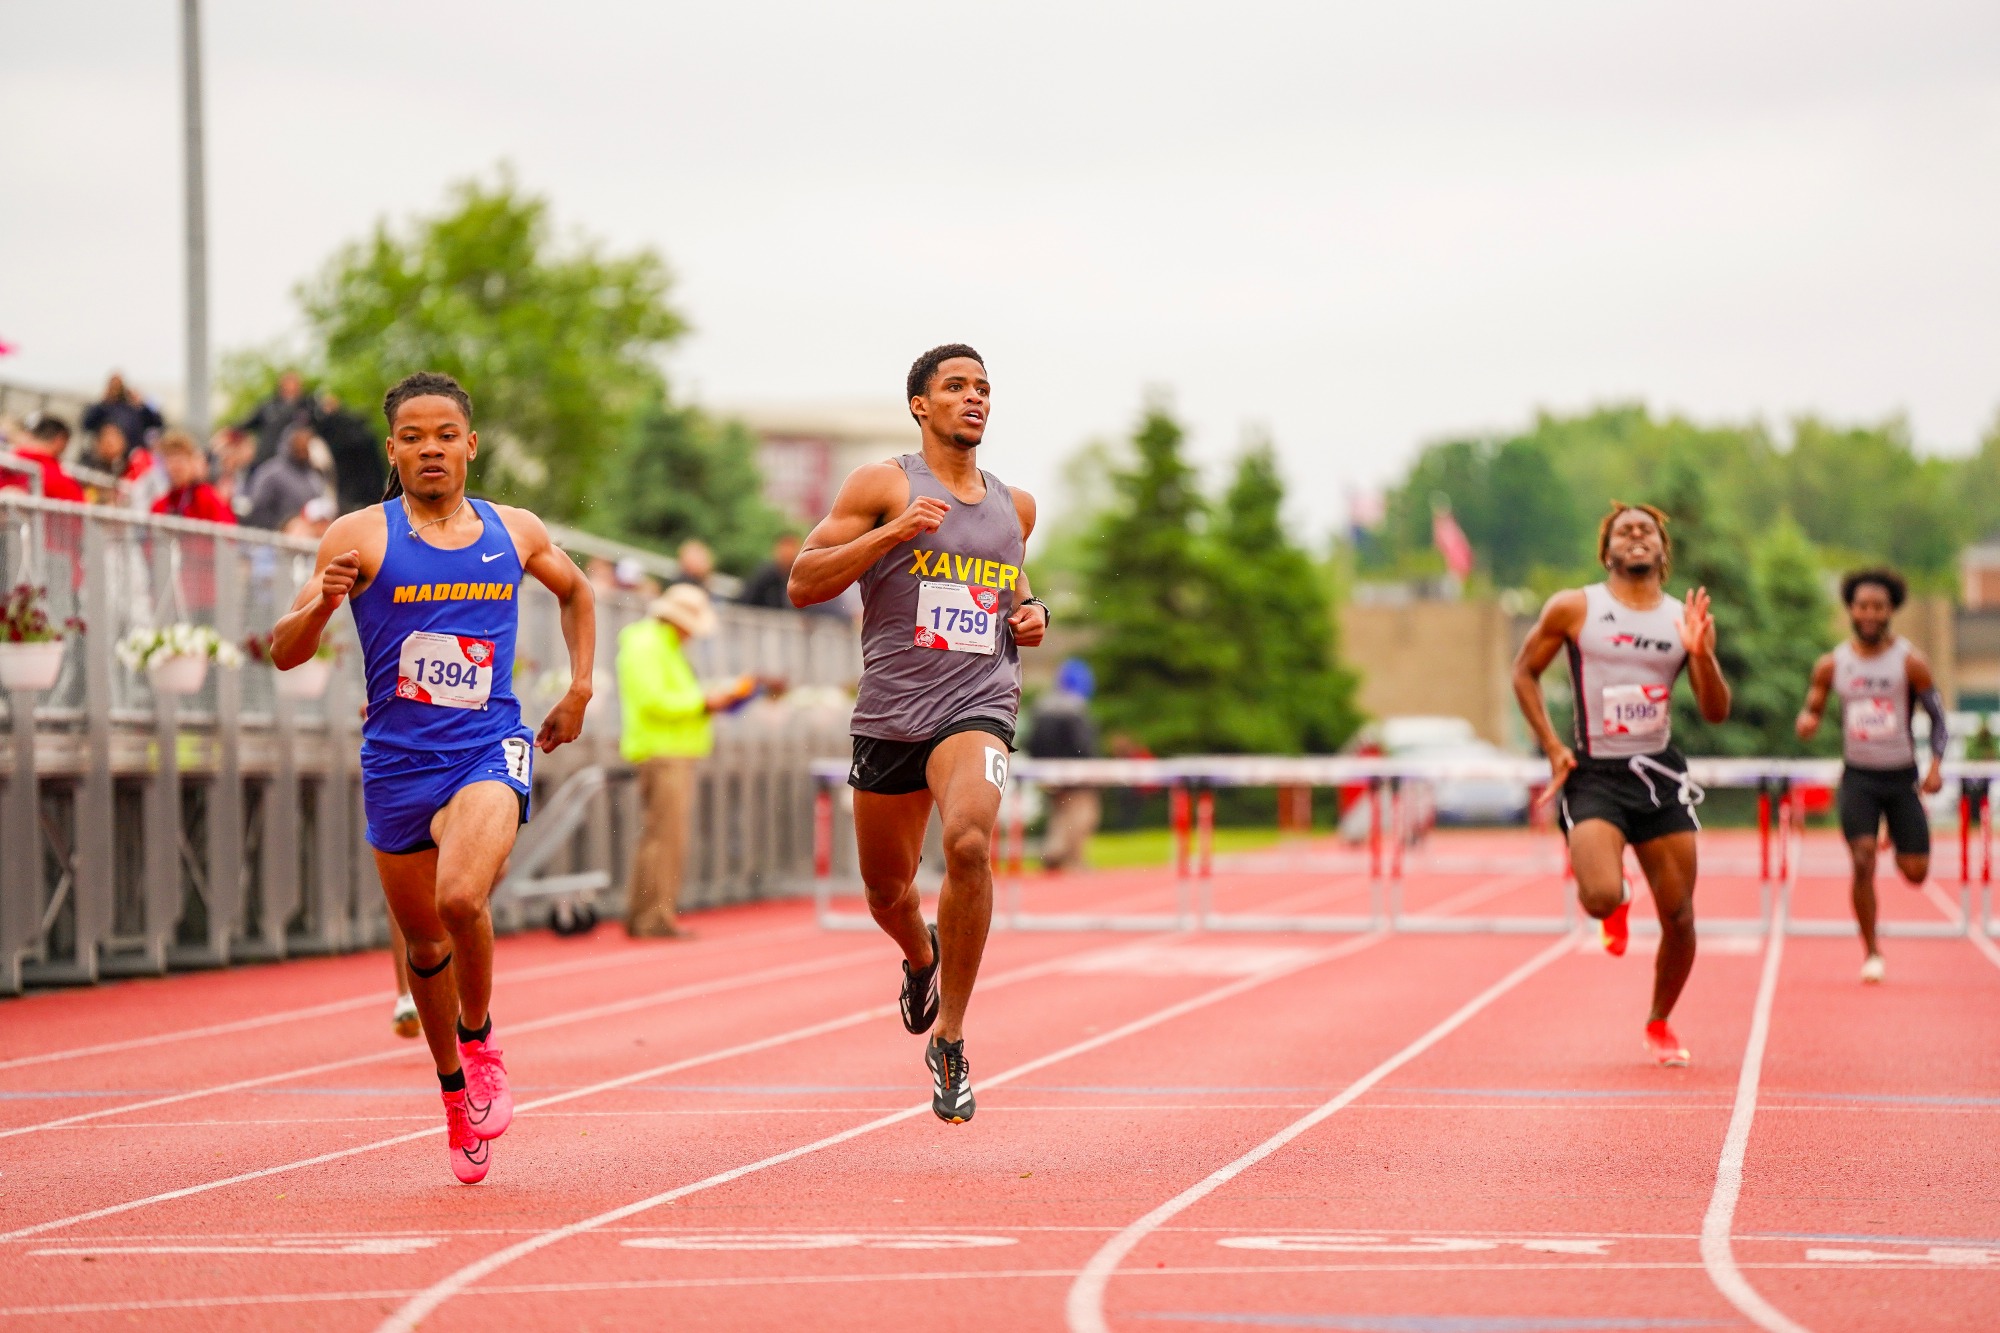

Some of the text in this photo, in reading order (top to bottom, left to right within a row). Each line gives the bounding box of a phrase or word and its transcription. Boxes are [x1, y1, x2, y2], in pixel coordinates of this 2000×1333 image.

[908, 549, 1019, 591] XAVIER
[393, 583, 513, 603] MADONNA
[931, 606, 988, 635] 1759
[414, 657, 478, 690] 1394
[508, 740, 526, 777] 7
[992, 753, 1006, 789] 6
